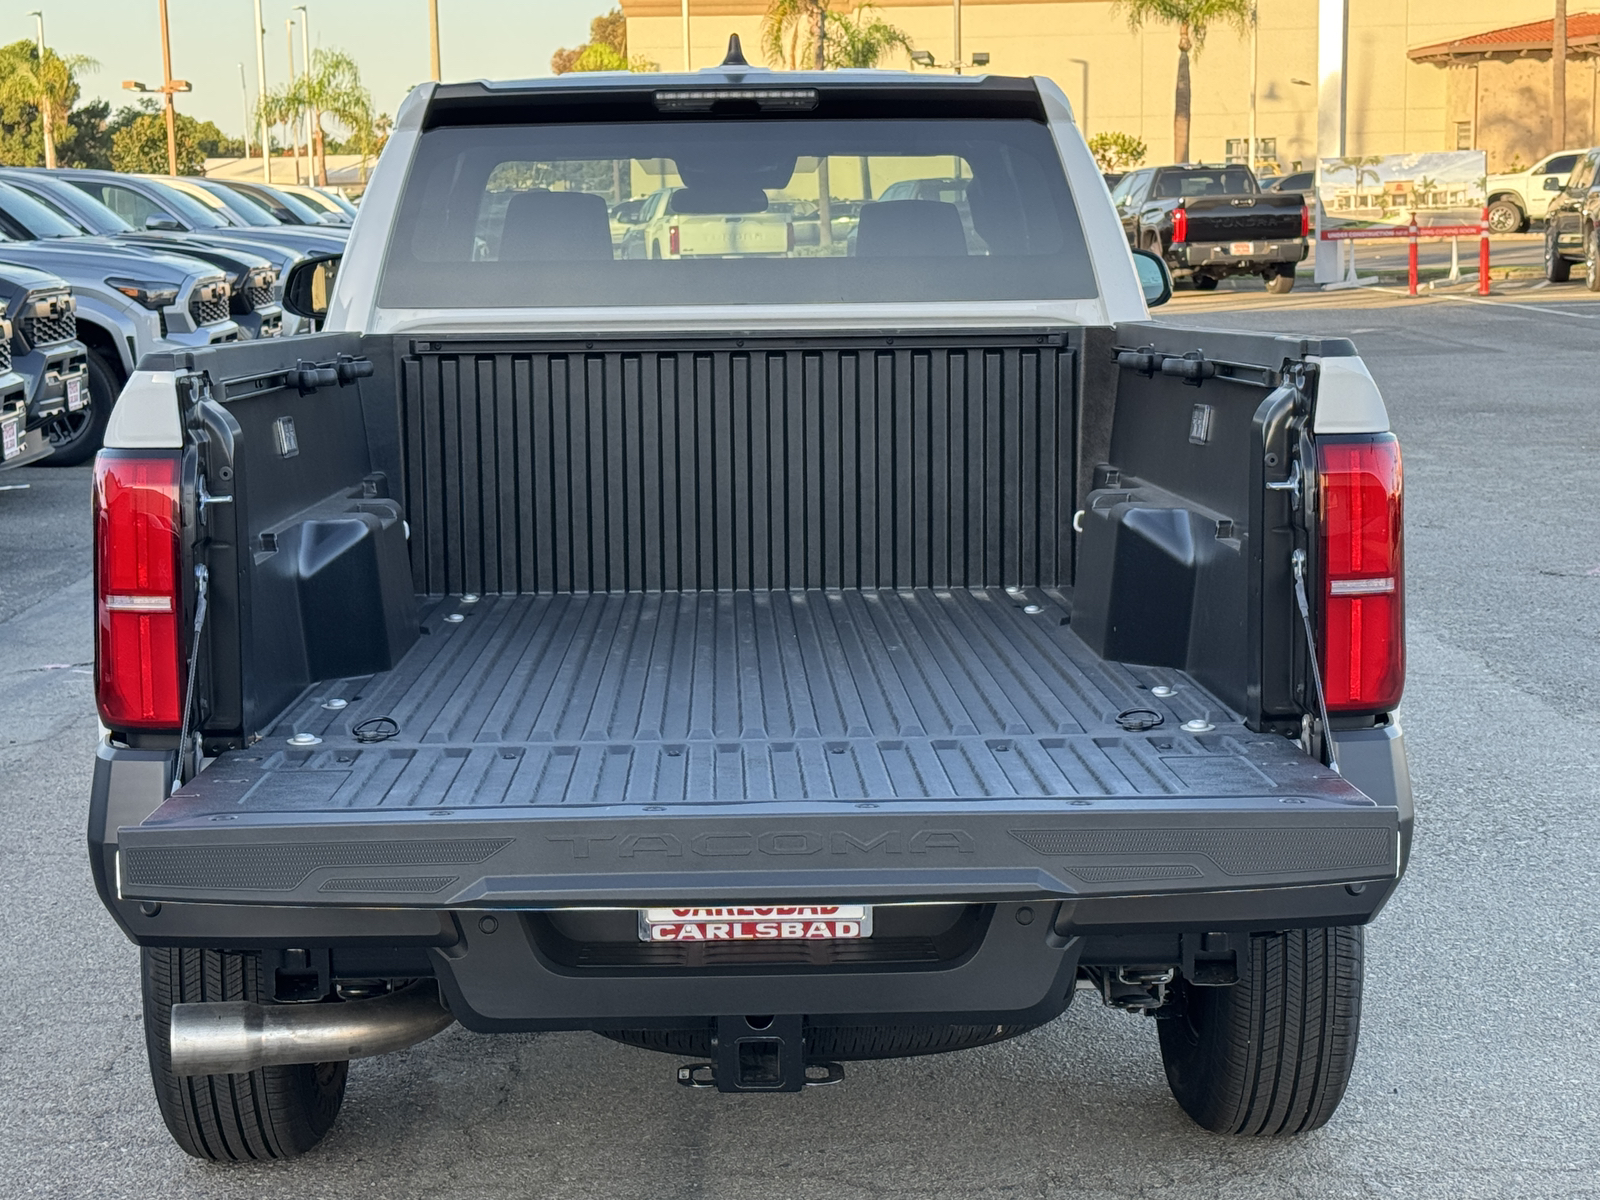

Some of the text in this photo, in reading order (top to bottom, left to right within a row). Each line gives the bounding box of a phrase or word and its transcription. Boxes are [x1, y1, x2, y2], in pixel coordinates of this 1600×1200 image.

[1210, 217, 1278, 228] TUNDRA
[544, 829, 976, 859] TACOMA
[651, 922, 860, 940] CARLSBAD
